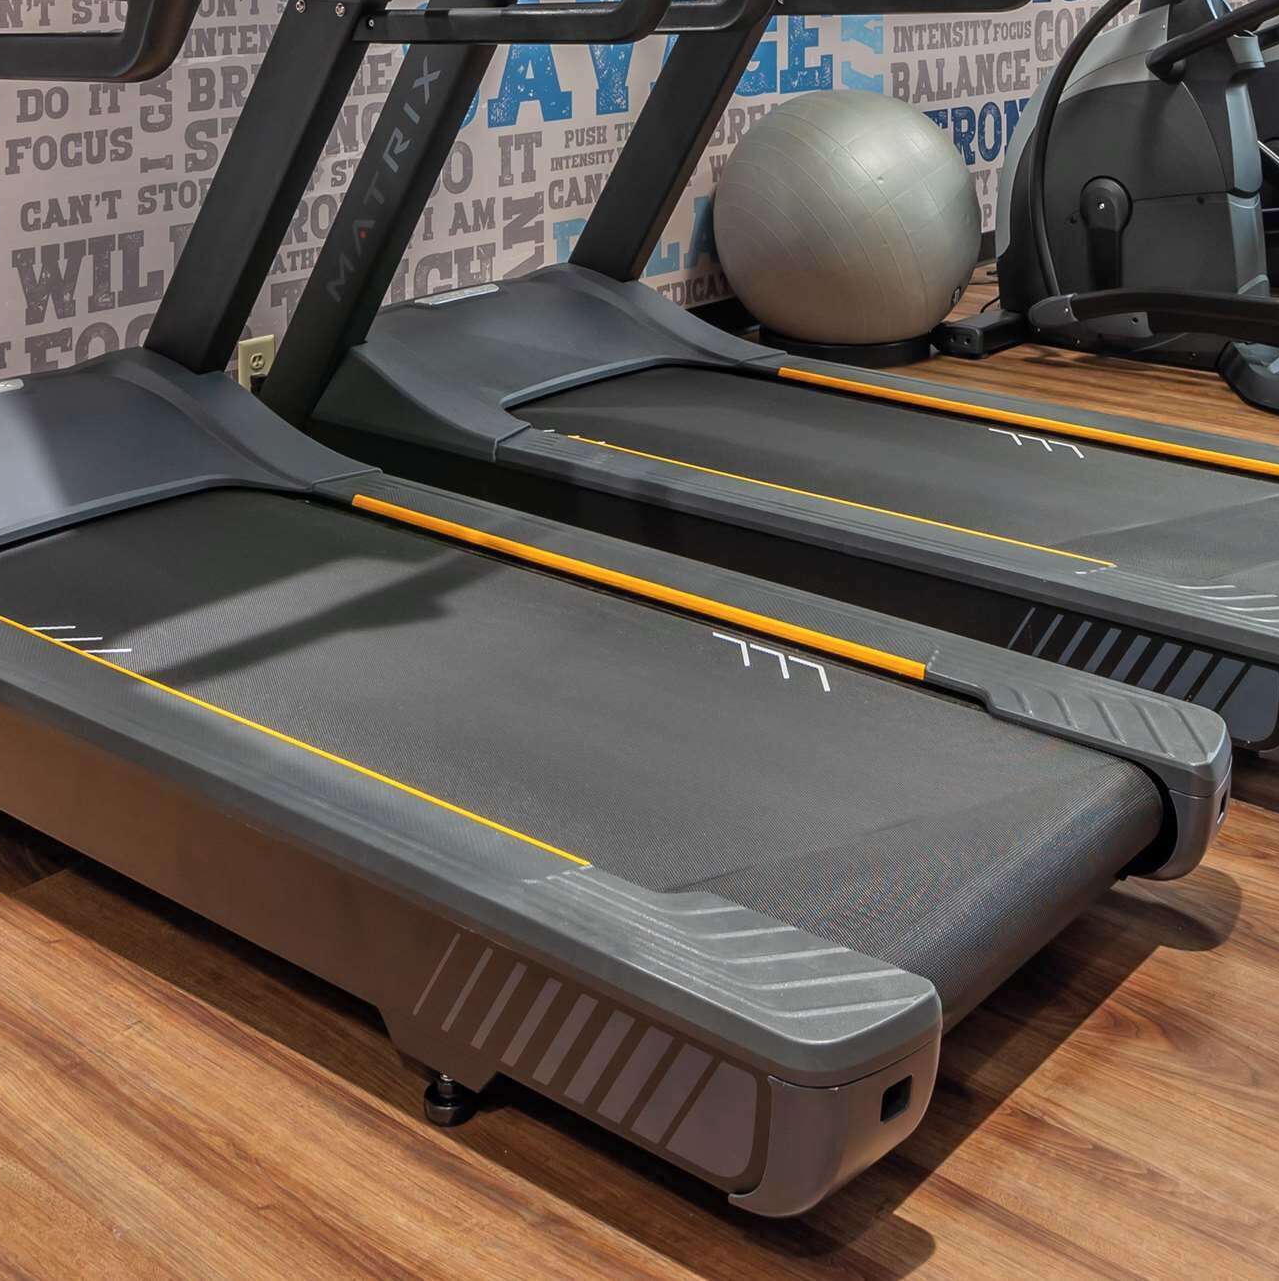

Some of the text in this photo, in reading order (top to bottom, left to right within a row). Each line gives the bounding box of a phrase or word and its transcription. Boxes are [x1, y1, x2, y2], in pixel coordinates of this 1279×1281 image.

[893, 19, 992, 53] INTENSITY
[993, 20, 1032, 42] FOCUS
[891, 49, 1031, 104] BALANCE
[16, 82, 127, 124] DO IT
[5, 126, 134, 175] FOCUS
[564, 125, 608, 150] PUSH
[325, 56, 442, 303] MATRIX
[498, 131, 542, 187] IT
[550, 149, 615, 172] INTENSITY
[21, 191, 122, 232] CAN'T
[448, 197, 496, 237] AM
